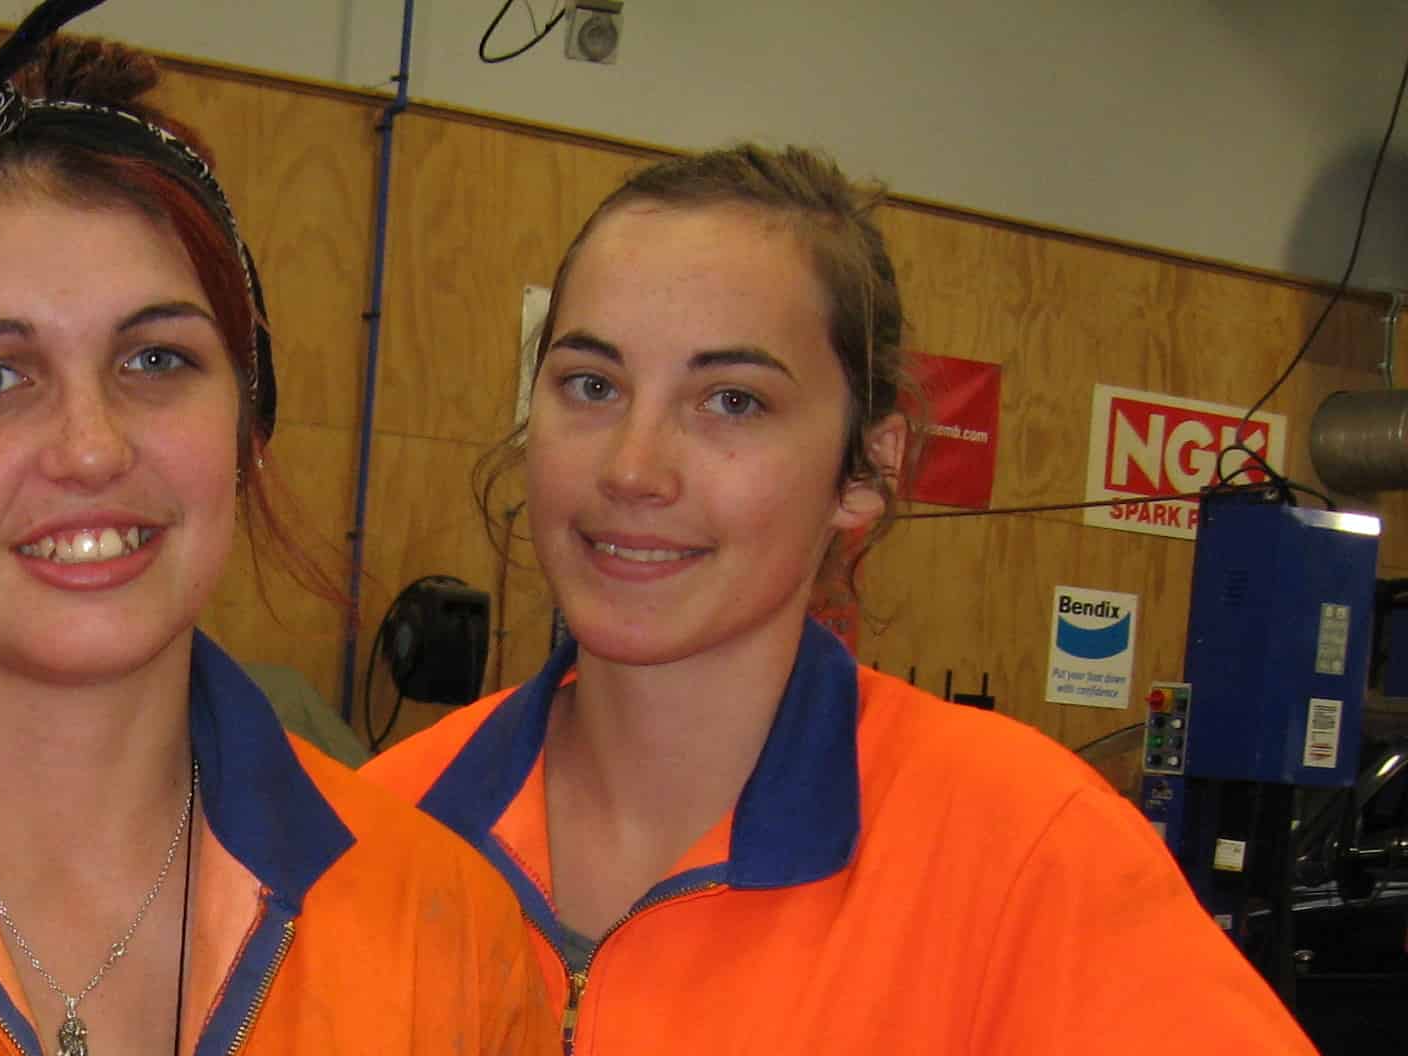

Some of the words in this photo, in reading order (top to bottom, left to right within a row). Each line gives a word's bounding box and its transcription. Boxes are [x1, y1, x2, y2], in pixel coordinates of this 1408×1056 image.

[1110, 408, 1265, 495] NGK
[1109, 498, 1181, 528] SPARK
[1059, 595, 1121, 619] Bendix
